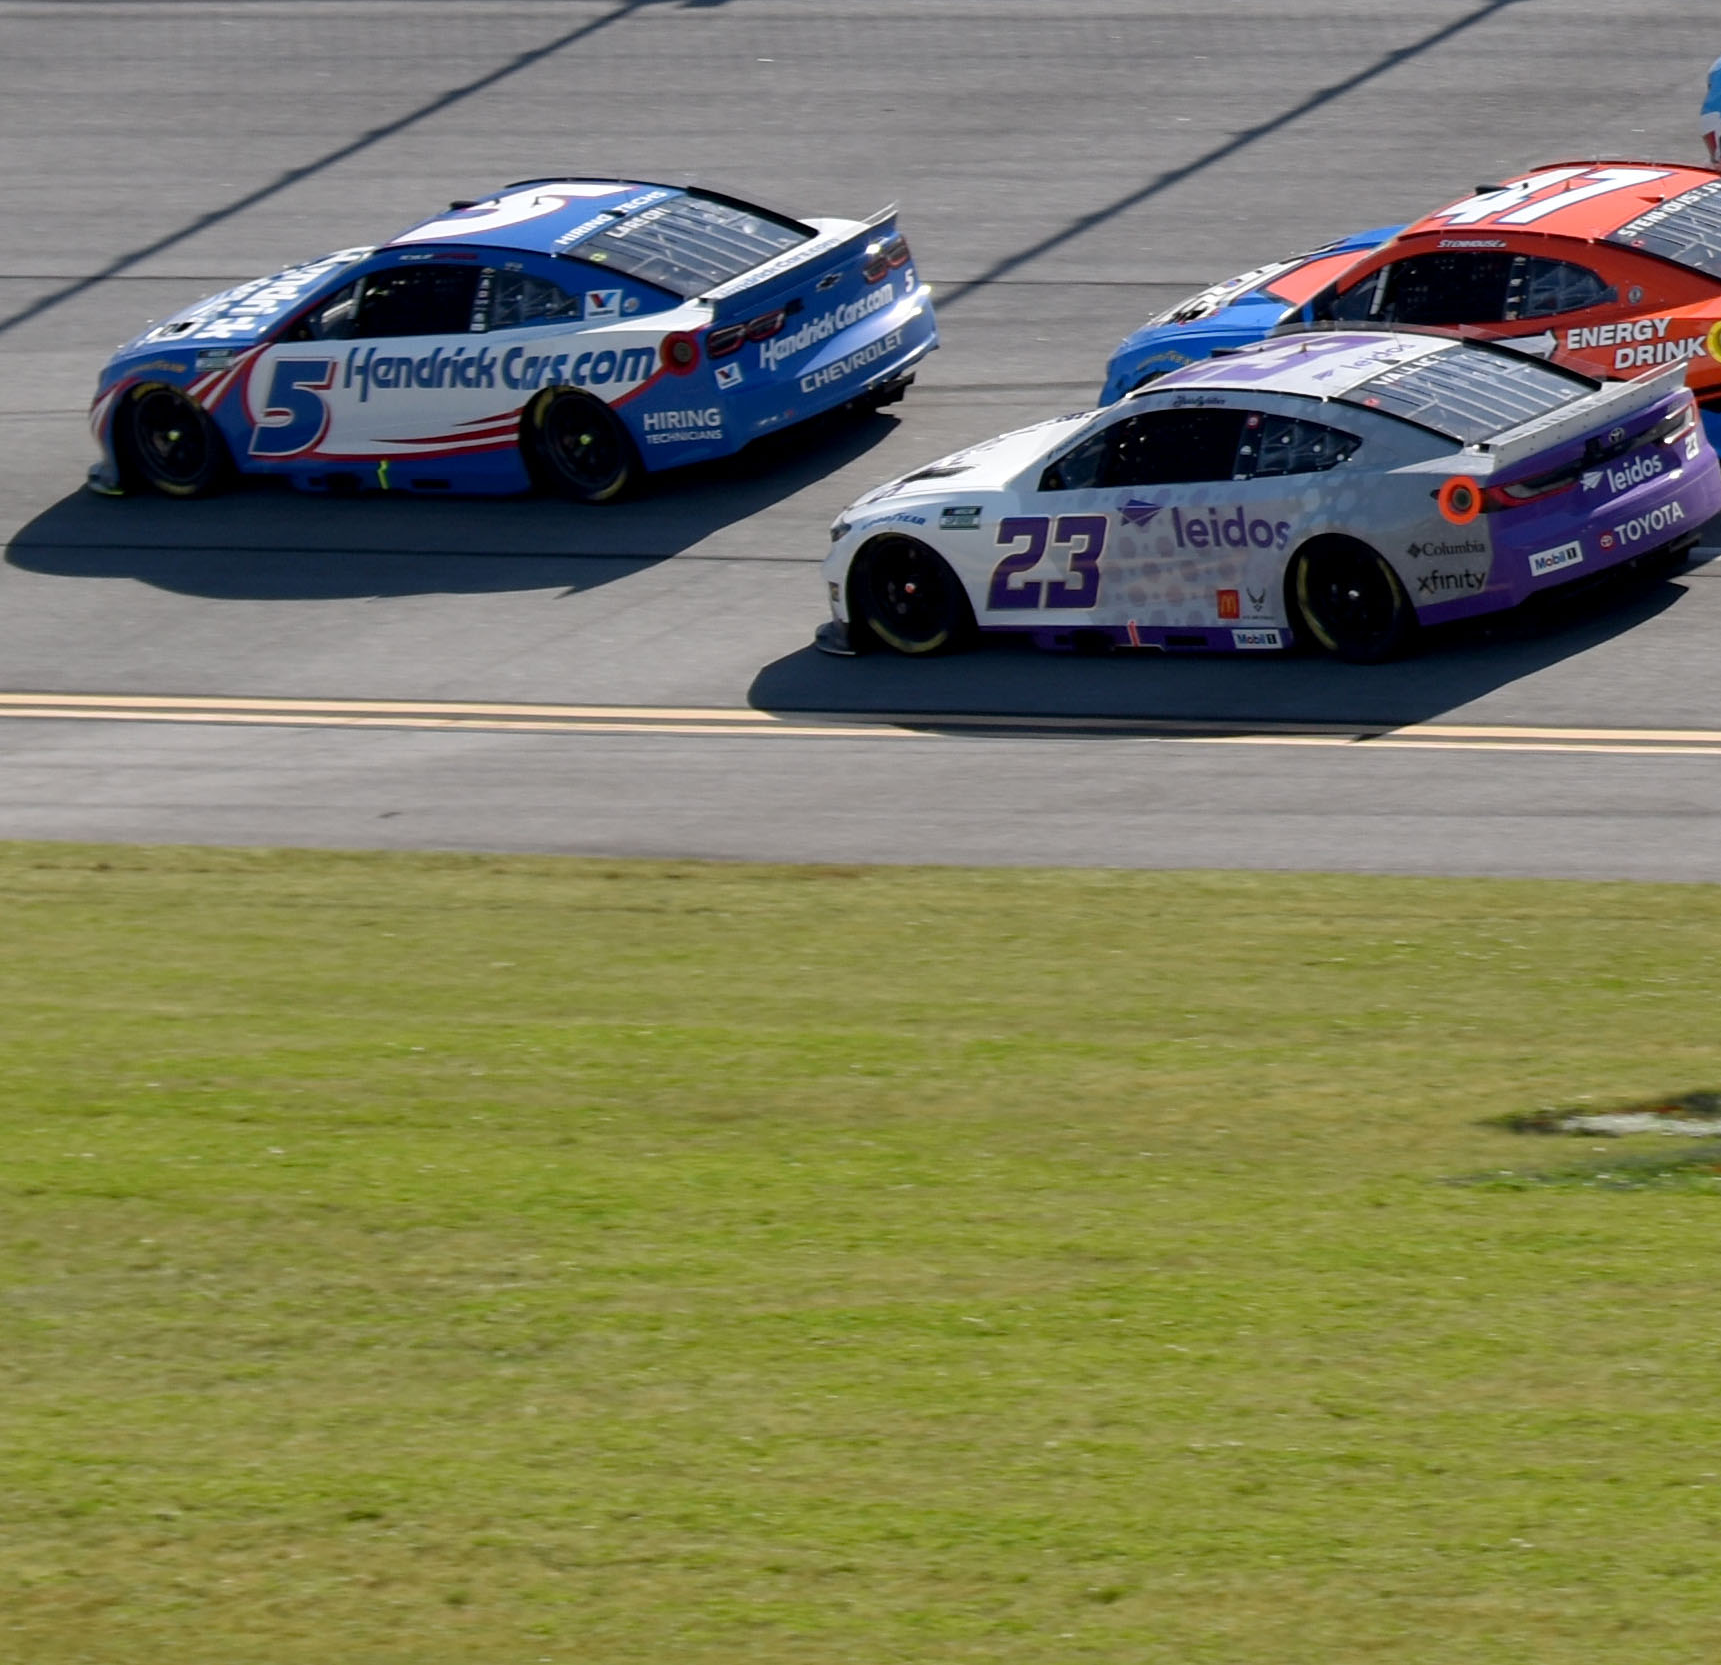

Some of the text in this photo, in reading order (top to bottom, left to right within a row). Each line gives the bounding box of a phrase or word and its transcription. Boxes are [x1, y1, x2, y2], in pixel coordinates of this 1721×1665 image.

[555, 214, 613, 246] HIRING
[904, 269, 915, 293] 5
[1567, 318, 1671, 350] ENERGY
[801, 334, 902, 393] CHEVROLET
[1615, 336, 1706, 370] DRINK
[247, 356, 339, 458] 5
[643, 408, 721, 431] HIRING
[646, 429, 723, 444] TECHNICIANS
[1606, 455, 1663, 493] leidos
[1172, 505, 1291, 551] leidos
[1614, 501, 1685, 545] TOYOTA
[986, 514, 1108, 611] 23
[1423, 540, 1486, 556] Columbia
[1534, 550, 1566, 571] Mobil
[1417, 569, 1487, 595] xfinity
